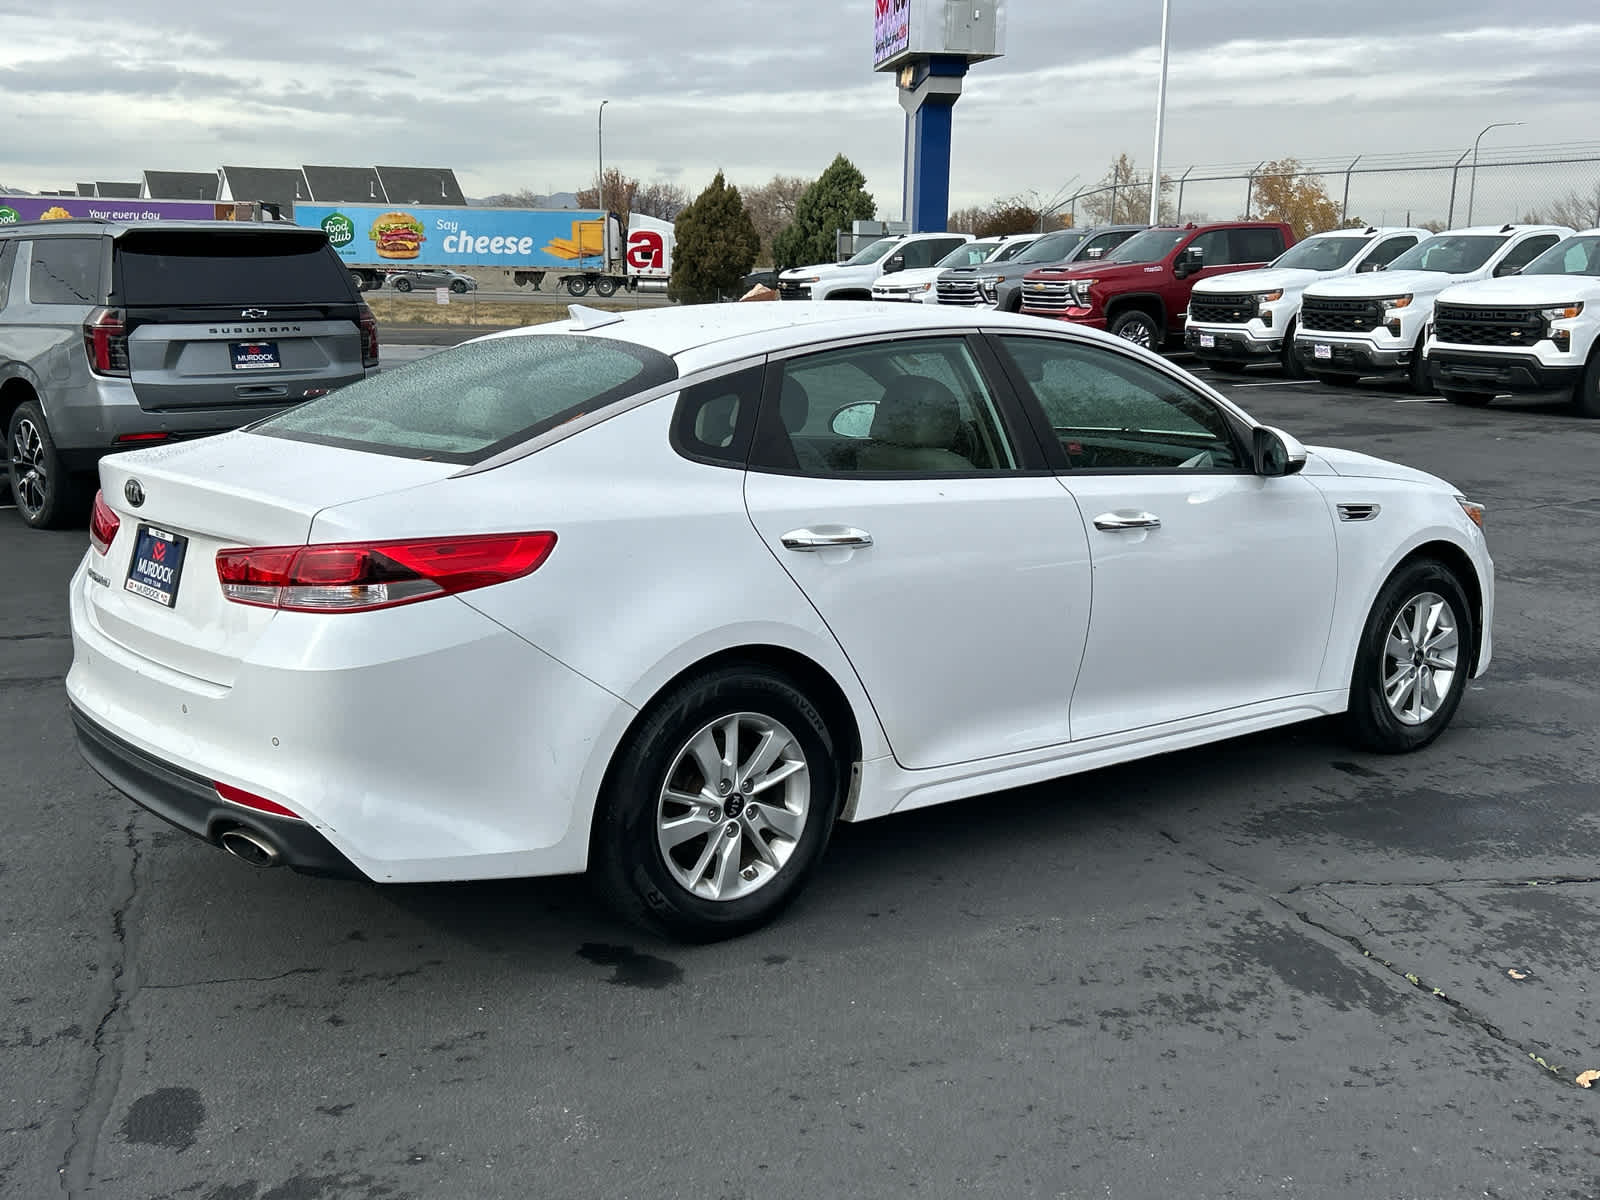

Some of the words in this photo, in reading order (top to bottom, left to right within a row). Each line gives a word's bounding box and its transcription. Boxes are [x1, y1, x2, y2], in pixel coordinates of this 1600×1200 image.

[0, 212, 16, 225] ood
[89, 209, 111, 219] Your
[112, 211, 139, 220] every
[141, 210, 160, 220] day
[325, 220, 349, 233] food
[436, 219, 458, 232] Say
[329, 230, 351, 243] club
[443, 230, 533, 255] cheese
[209, 326, 302, 334] SUBURBAN
[237, 353, 274, 361] MURDOCK
[137, 558, 174, 584] MURDOCK
[136, 584, 161, 600] MURDOCK
